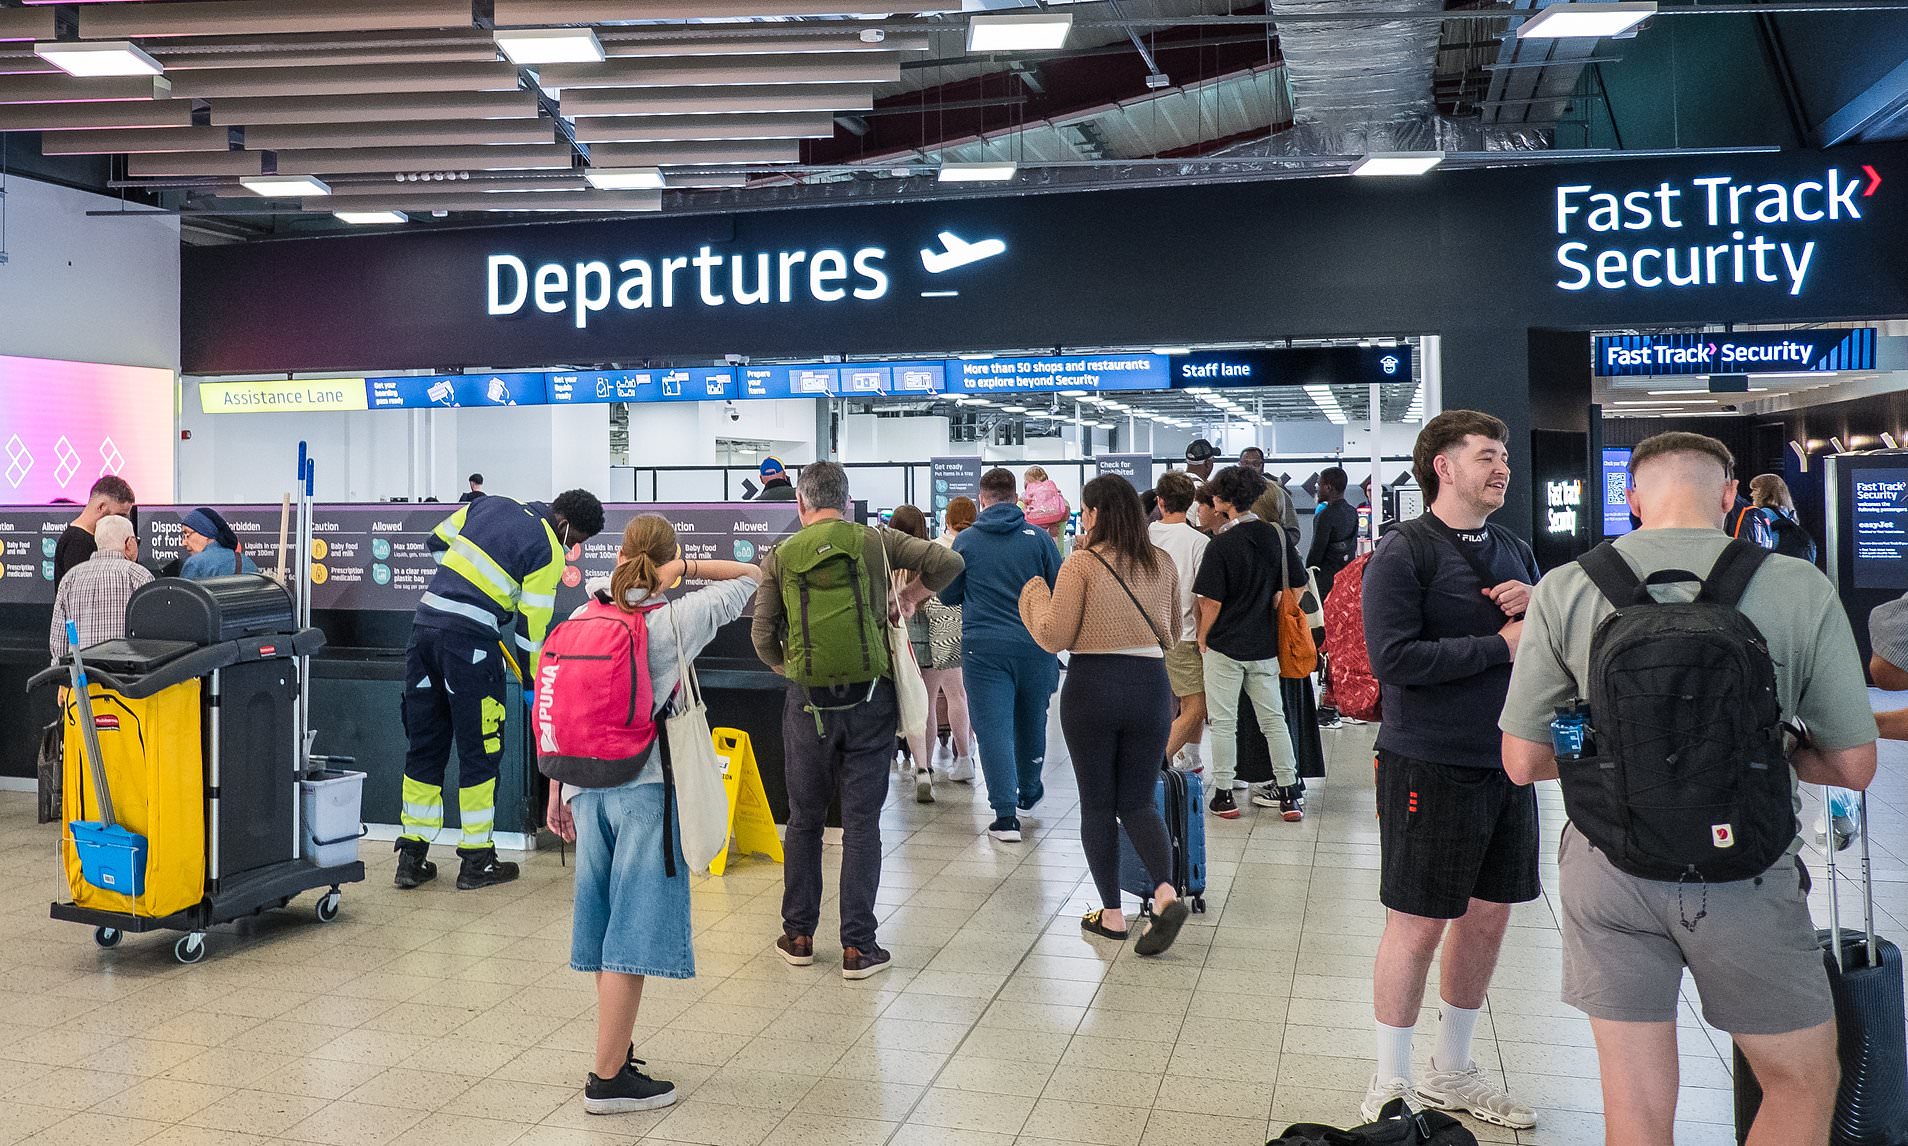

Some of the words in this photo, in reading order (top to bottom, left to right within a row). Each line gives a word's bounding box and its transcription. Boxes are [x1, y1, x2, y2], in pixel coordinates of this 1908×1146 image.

[1556, 182, 1683, 234] Fast
[1693, 168, 1862, 226] Track
[1556, 231, 1816, 296] Security
[487, 245, 889, 329] Departures
[1607, 345, 1652, 365] Fast
[1653, 343, 1711, 364] Track
[1721, 341, 1813, 365] Security
[963, 364, 989, 374] More
[990, 362, 1015, 374] than
[1017, 362, 1031, 373] 50
[1033, 361, 1063, 374] shops
[1065, 360, 1085, 372] and
[1087, 359, 1150, 371] restaurants
[1182, 362, 1219, 377] Staff
[1221, 362, 1250, 376] lane
[746, 370, 771, 379] Prepare
[747, 379, 761, 388] your
[964, 378, 976, 388] to
[977, 376, 1014, 389] explore
[1016, 375, 1053, 389] beyond
[1055, 374, 1100, 387] Security
[223, 389, 302, 406] Assistance
[307, 388, 344, 403] Lane
[946, 463, 963, 471] ready
[1120, 460, 1131, 468] for
[1856, 482, 1878, 491] Fast
[1878, 482, 1904, 491] Track
[1856, 491, 1898, 501] Security
[0, 521, 15, 531] tion
[41, 521, 68, 531] Allowed
[151, 521, 182, 535] Dispos
[227, 521, 261, 531] orbidden
[311, 522, 339, 532] Caution
[372, 521, 403, 532] Allowed
[672, 522, 695, 532] ution
[733, 521, 768, 532] Allowed
[1858, 521, 1894, 529] easyJet
[151, 534, 162, 547] of
[1462, 534, 1482, 542] FILA
[6, 541, 18, 549] Baby
[244, 542, 263, 550] Liquids
[270, 542, 297, 550] conner
[330, 542, 345, 551] Baby
[345, 542, 358, 550] food
[584, 544, 606, 552] Liquids
[607, 544, 614, 552] in
[685, 544, 701, 553] Baby
[702, 544, 717, 552] food
[152, 548, 179, 560] items
[257, 549, 275, 557] 100ml
[330, 549, 342, 557] and
[330, 566, 364, 576] Prescription
[405, 567, 420, 575] clear
[420, 567, 438, 575] reseal
[584, 569, 610, 577] Scissors
[330, 574, 362, 582] medication
[393, 575, 413, 583] plastic
[413, 575, 425, 584] bag
[539, 664, 560, 721] PUMA
